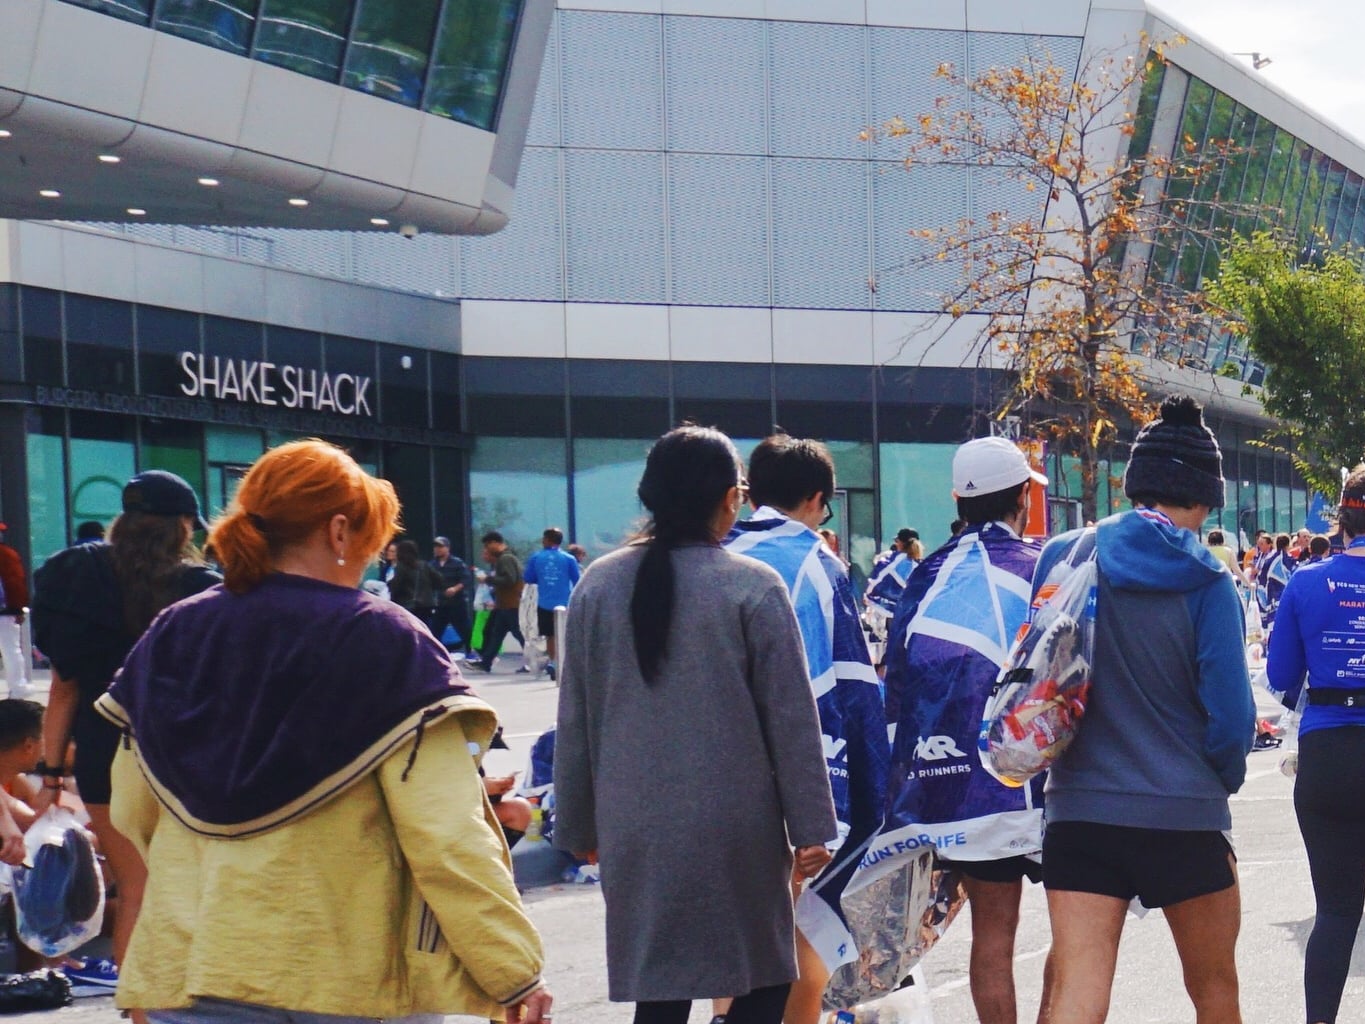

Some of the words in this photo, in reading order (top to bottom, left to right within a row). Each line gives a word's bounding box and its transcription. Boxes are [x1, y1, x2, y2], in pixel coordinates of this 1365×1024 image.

[180, 351, 278, 406] SHAKE
[281, 366, 372, 417] SHACK
[918, 763, 971, 779] RUNNERS
[895, 833, 933, 854] FOR
